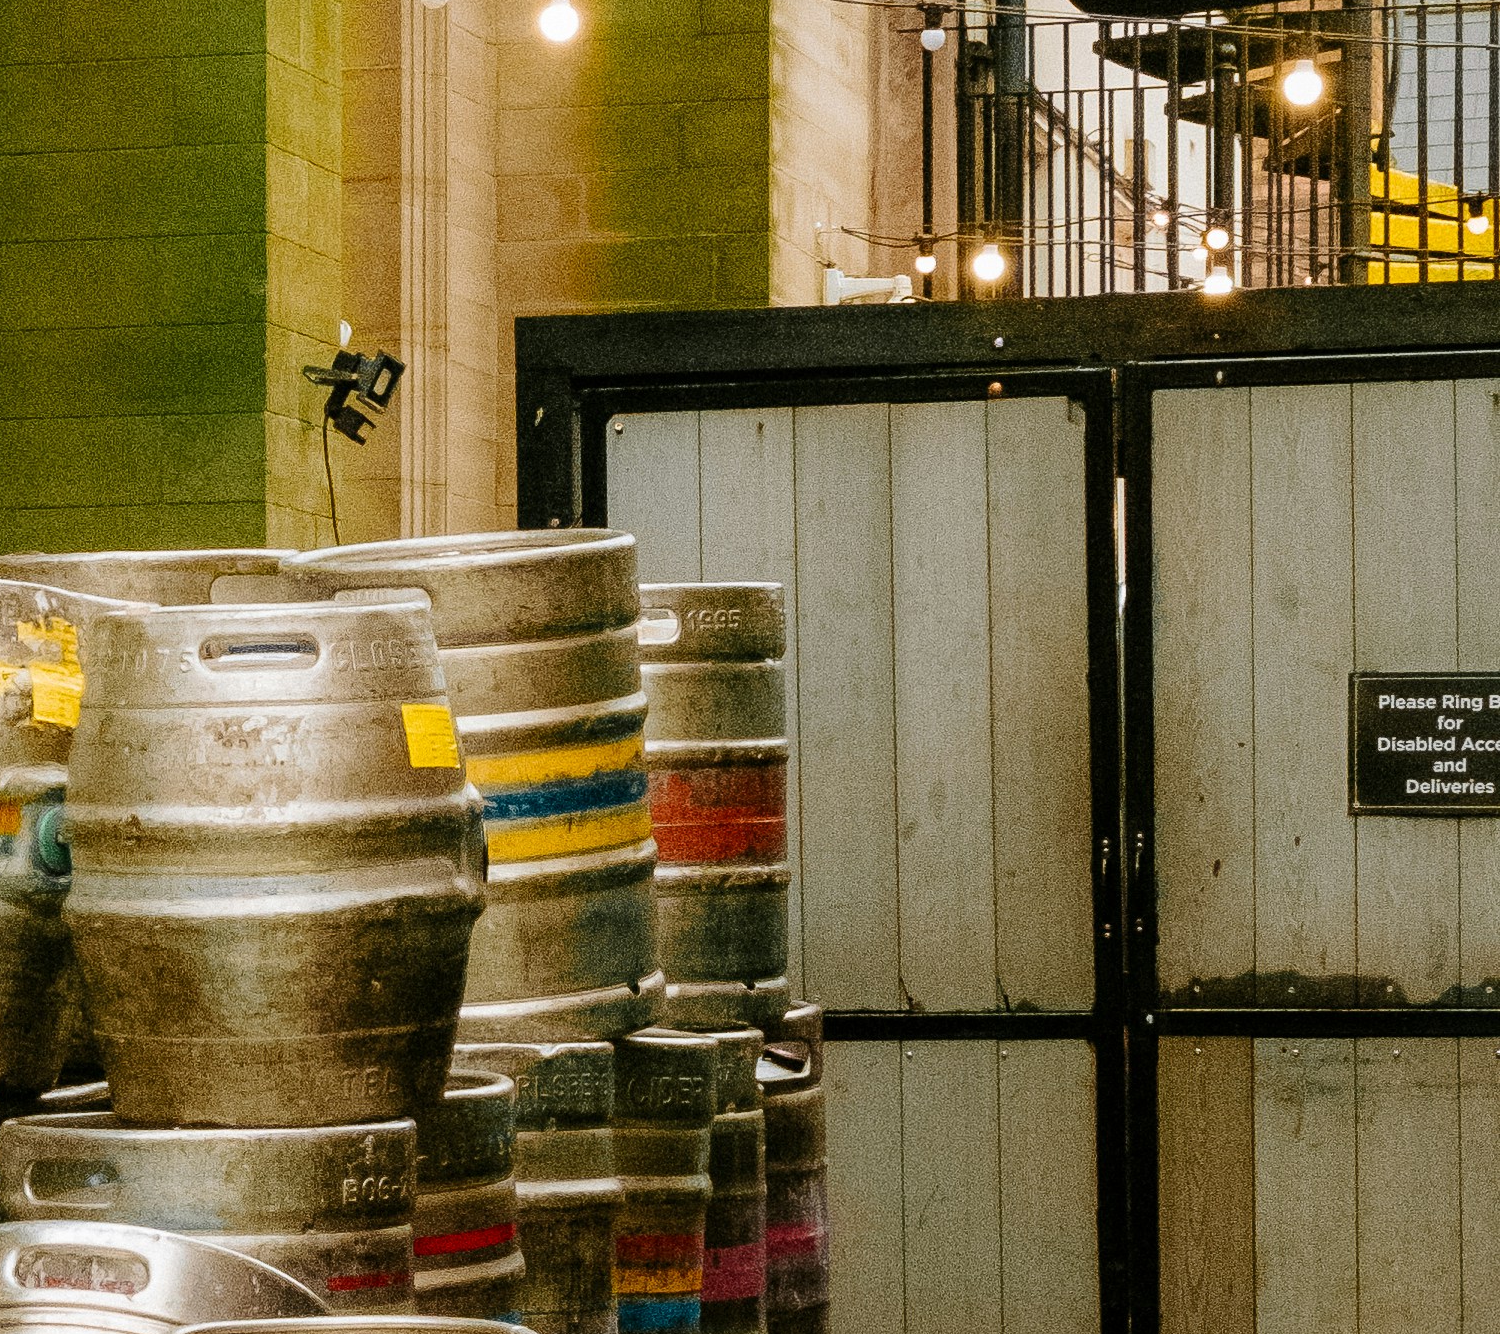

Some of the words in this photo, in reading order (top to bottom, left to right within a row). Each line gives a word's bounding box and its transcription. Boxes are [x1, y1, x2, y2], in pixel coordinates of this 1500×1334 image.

[1378, 694, 1437, 710] Please
[1442, 694, 1483, 712] Ring
[1436, 715, 1464, 731] for
[1377, 736, 1456, 752] Disabled
[1432, 757, 1467, 773] and
[1405, 778, 1495, 794] Deliveries
